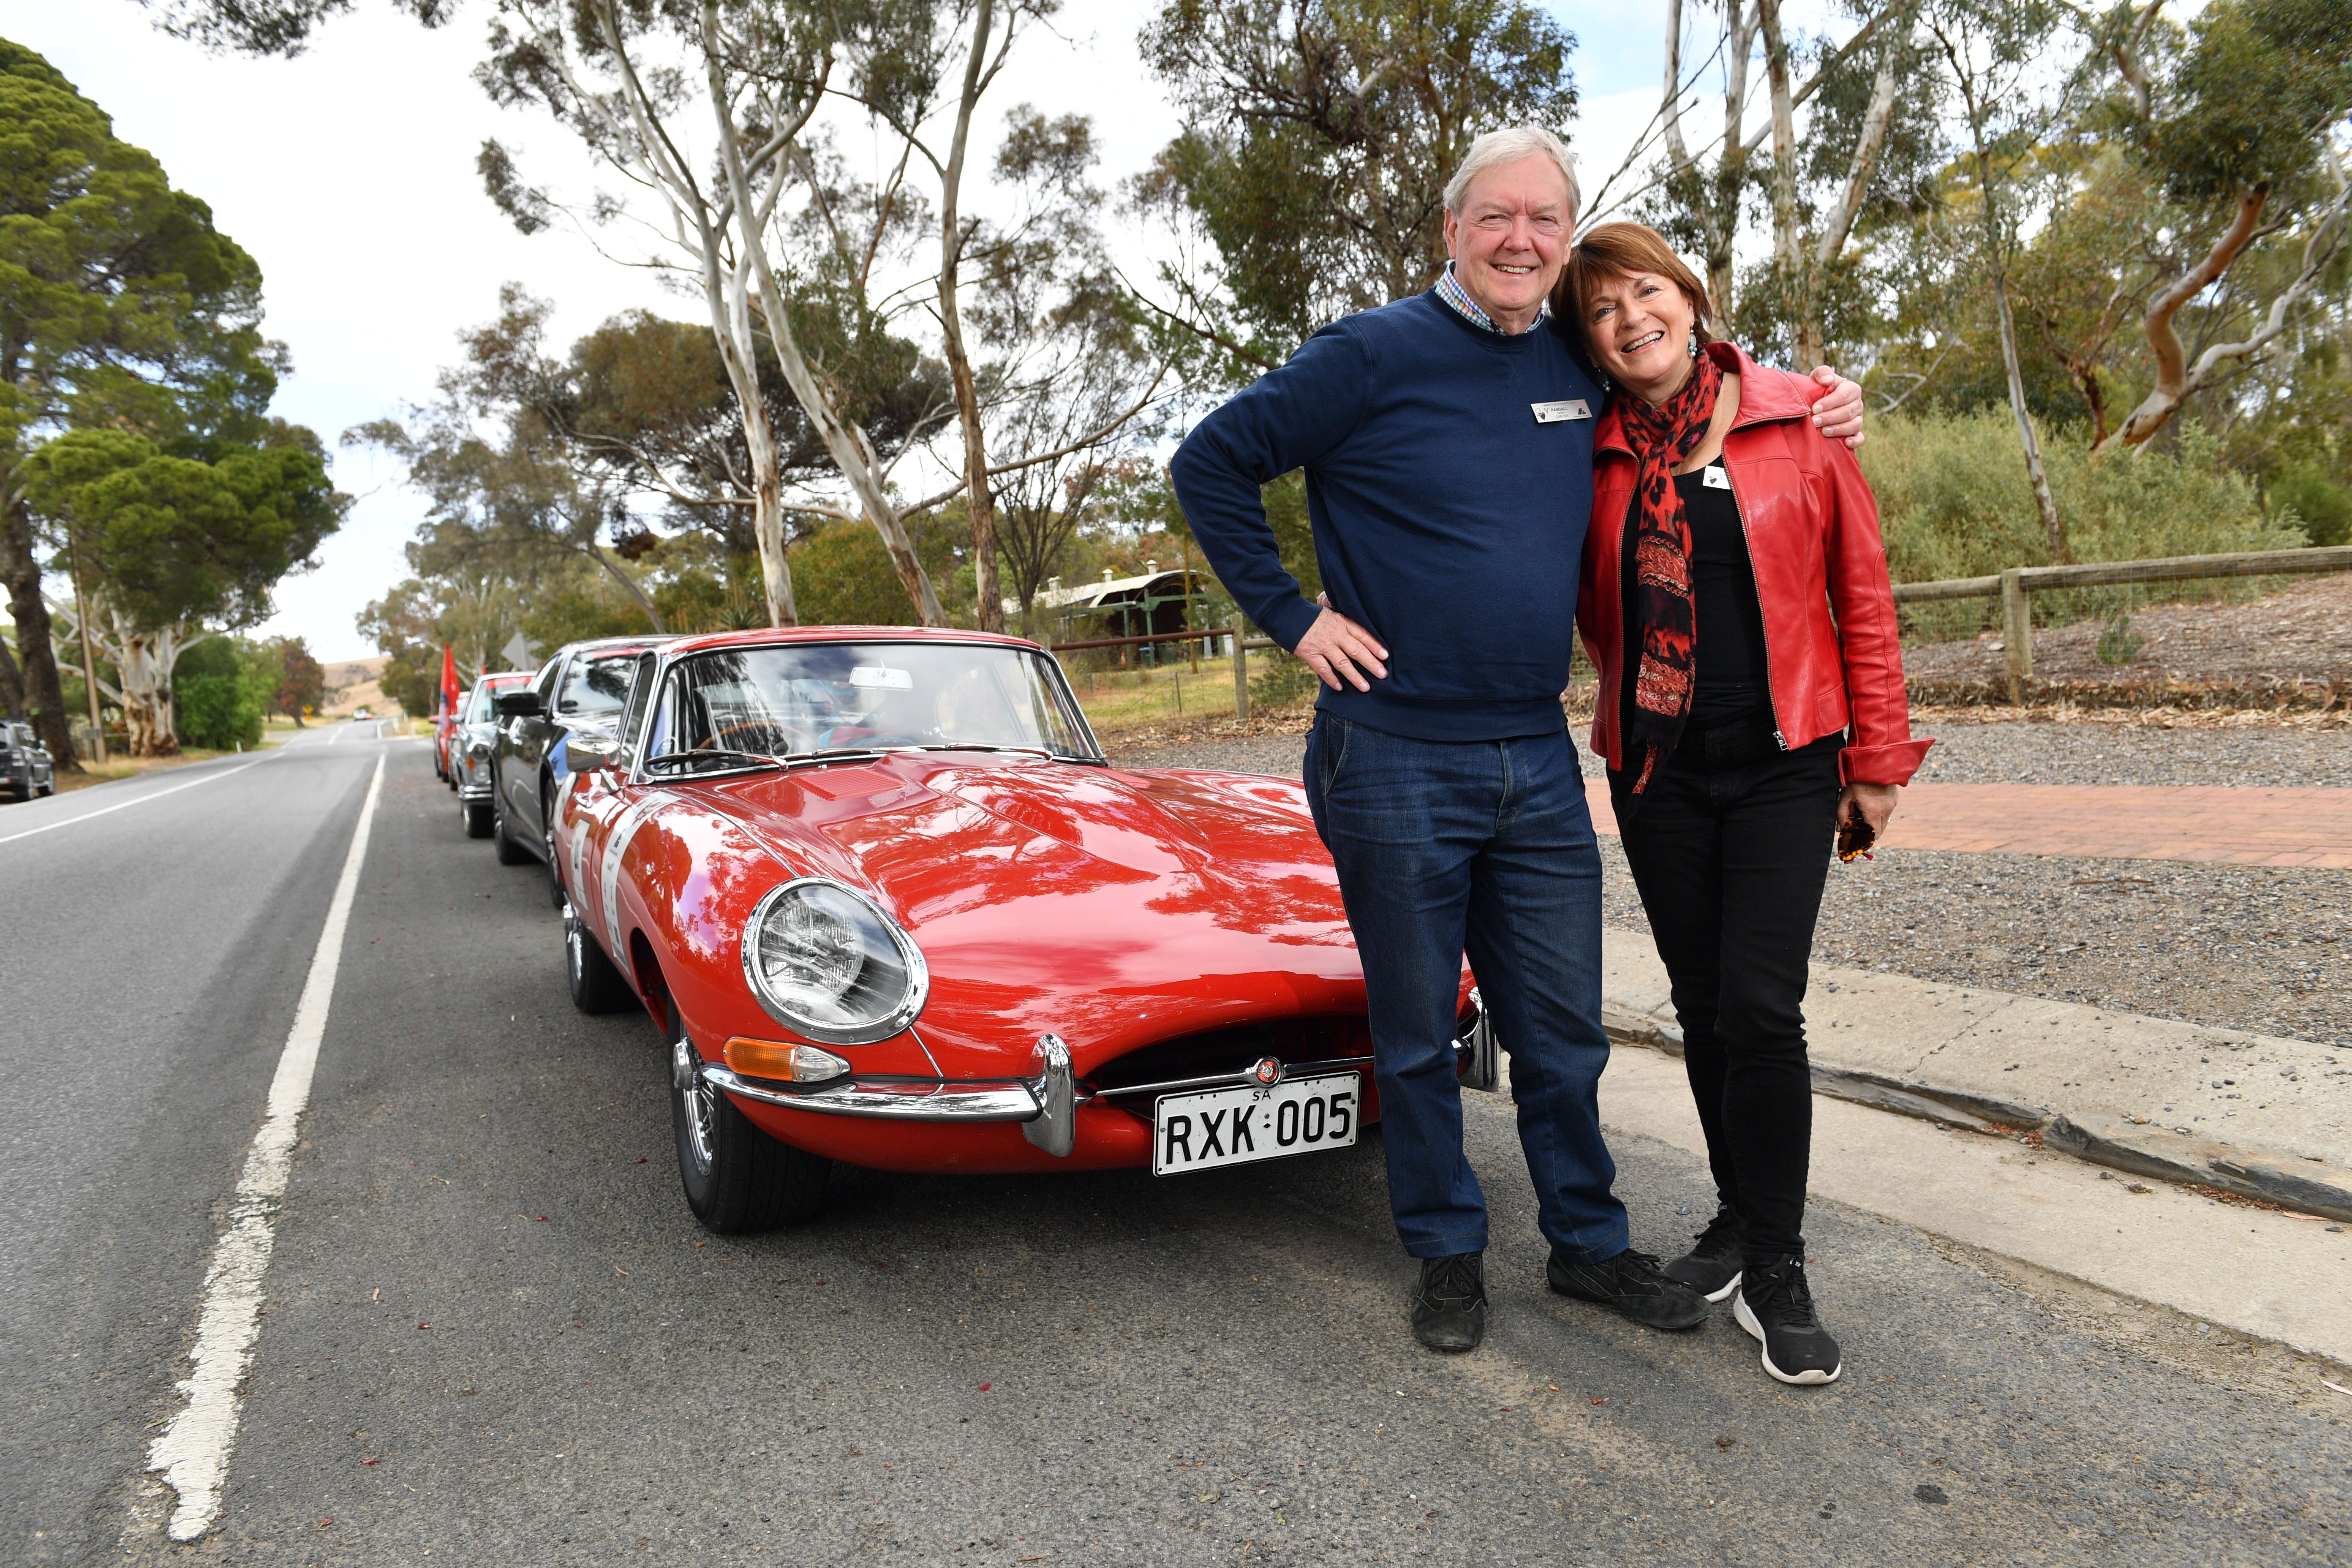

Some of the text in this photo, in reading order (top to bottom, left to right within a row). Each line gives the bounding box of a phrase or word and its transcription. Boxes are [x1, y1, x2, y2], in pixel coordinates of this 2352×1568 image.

[1252, 1091, 1271, 1101] SA
[1165, 1092, 1352, 1165] RXK 005
